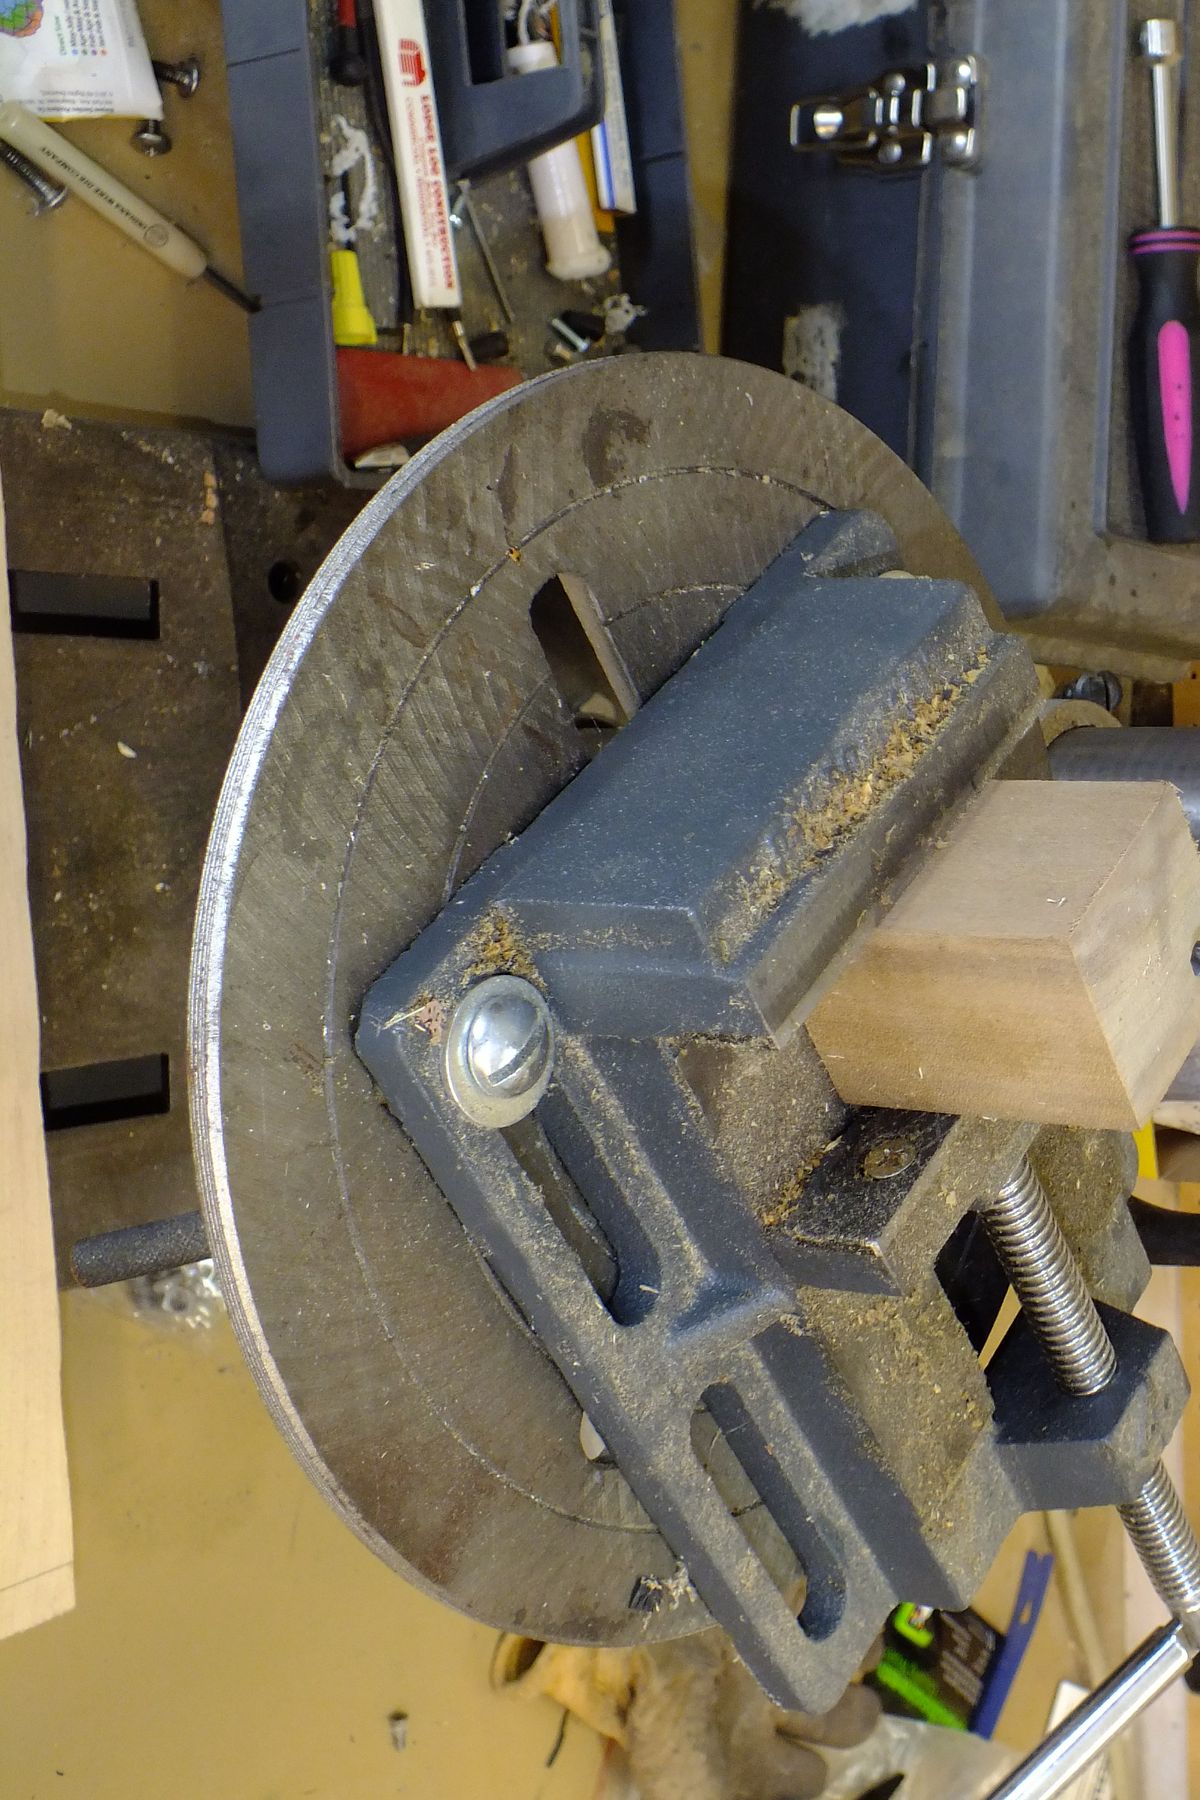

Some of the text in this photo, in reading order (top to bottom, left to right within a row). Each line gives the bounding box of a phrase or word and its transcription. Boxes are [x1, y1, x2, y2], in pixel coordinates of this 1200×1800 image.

[41, 147, 80, 177] COMPANY
[94, 187, 115, 206] WIRE
[433, 180, 453, 288] CONSTRUCTION
